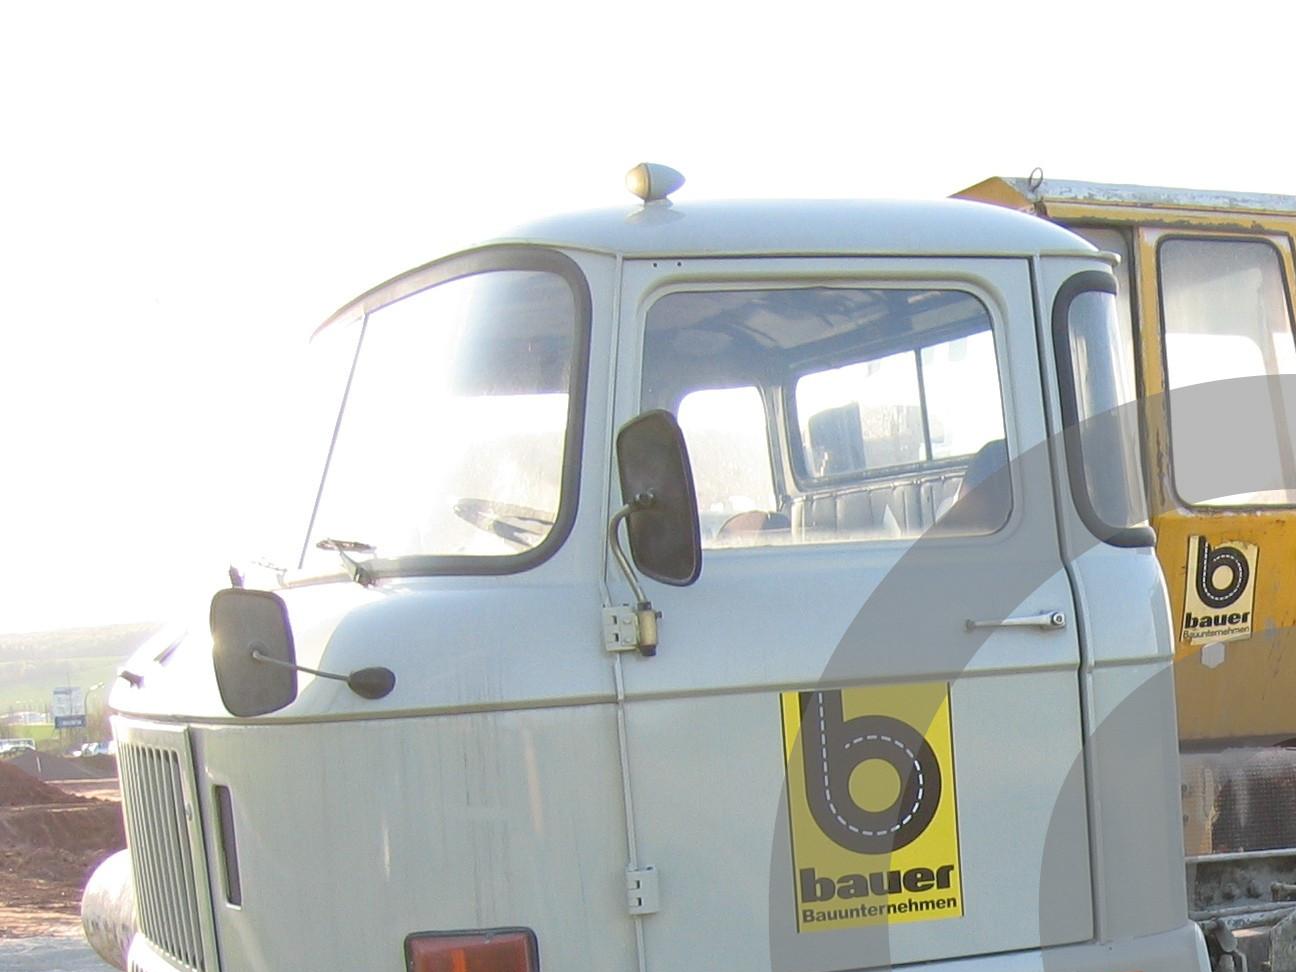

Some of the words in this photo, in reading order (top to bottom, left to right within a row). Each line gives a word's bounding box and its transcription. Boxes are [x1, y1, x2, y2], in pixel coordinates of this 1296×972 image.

[1184, 612, 1251, 629] bauer
[1183, 626, 1250, 639] Bauunternehmen
[799, 864, 955, 903] bauer
[802, 897, 957, 923] Bauunternehmen
